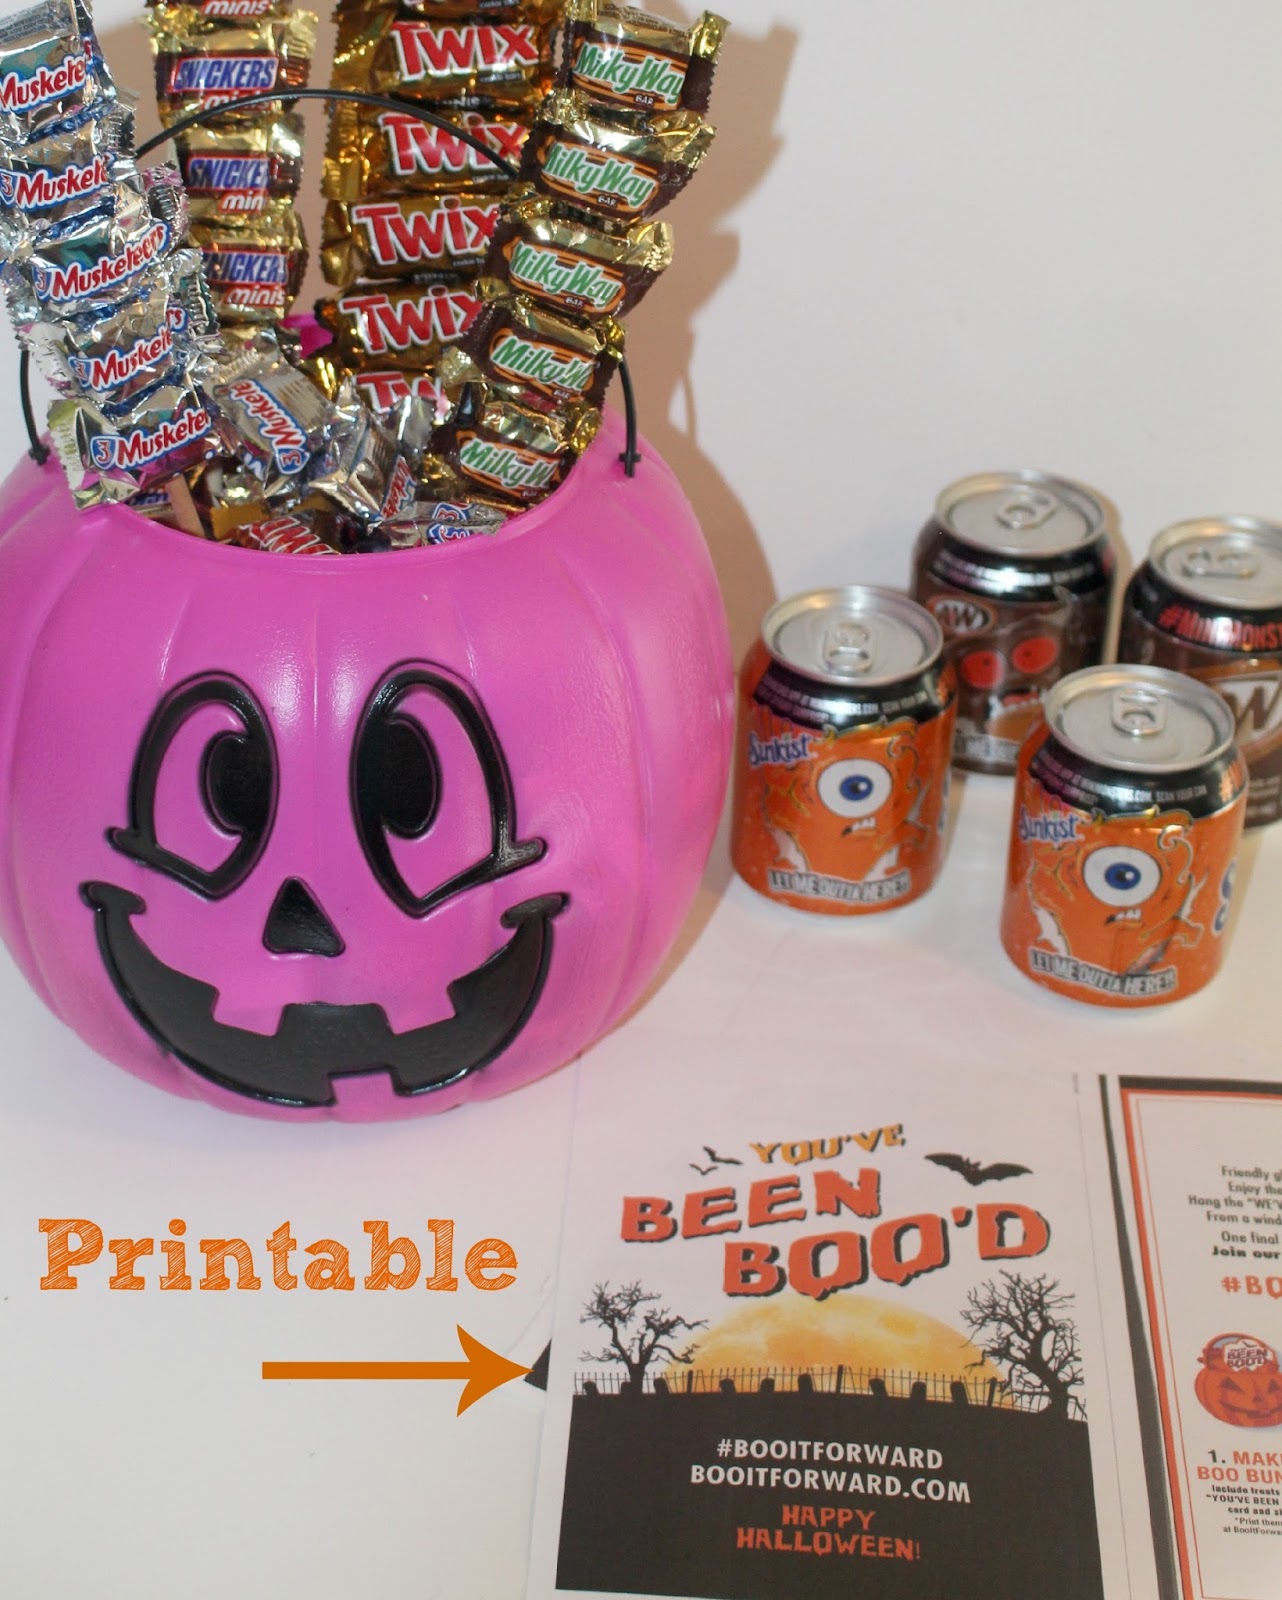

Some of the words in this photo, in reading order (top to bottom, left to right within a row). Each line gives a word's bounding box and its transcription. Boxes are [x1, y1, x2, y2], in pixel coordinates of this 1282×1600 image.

[174, 58, 276, 90] SNICKERS
[52, 225, 165, 298] Musketeers
[750, 732, 813, 766] Sunkist
[1020, 808, 1080, 842] Sunkist
[749, 1123, 907, 1165] YOU'VE
[1221, 1165, 1269, 1181] Friendly
[1228, 1181, 1260, 1195] Enjoy
[620, 1167, 883, 1243] BEEN
[1188, 1194, 1221, 1209] Hang
[1224, 1197, 1244, 1208] the
[1206, 1210, 1239, 1222] From
[1242, 1215, 1250, 1224] a
[1221, 1230, 1247, 1243] One
[1250, 1231, 1279, 1245] final
[723, 1202, 1051, 1300] BOO'D
[1212, 1245, 1247, 1257] Join
[1253, 1250, 1280, 1259] our
[717, 1438, 943, 1469] #BOOITFORWARD
[1208, 1449, 1226, 1464] 1.
[1233, 1451, 1282, 1467] MAK
[690, 1464, 971, 1504] BOOITFORWARD.COM
[1197, 1466, 1240, 1482] BOO
[1211, 1484, 1248, 1494] Include
[1251, 1487, 1280, 1496] treats
[1228, 1507, 1250, 1515] card
[1252, 1508, 1271, 1516] and
[1253, 1497, 1280, 1506] BEEN
[781, 1504, 876, 1530] HAPPY
[736, 1527, 920, 1562] HALLOWEEN!
